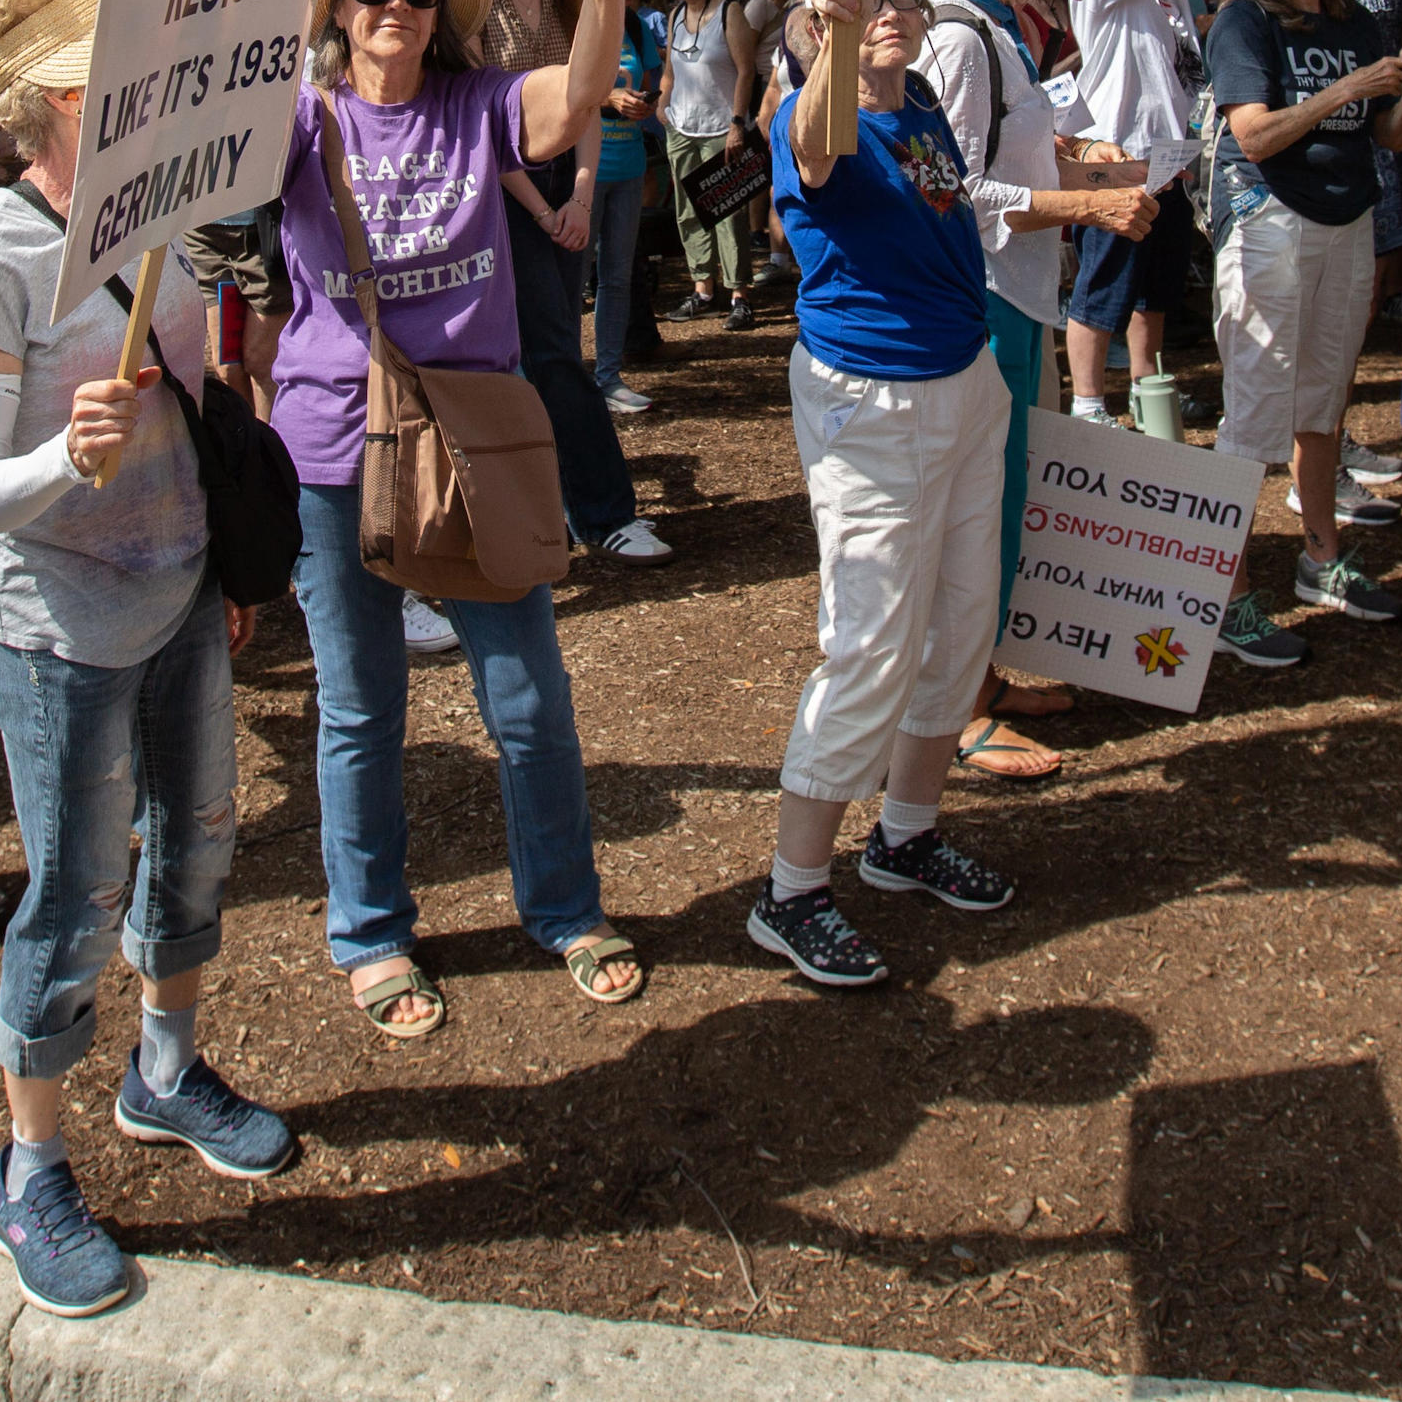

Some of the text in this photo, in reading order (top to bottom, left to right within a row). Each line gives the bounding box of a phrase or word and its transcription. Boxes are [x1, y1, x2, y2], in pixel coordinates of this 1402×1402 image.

[1286, 47, 1358, 76] LOVE
[97, 34, 301, 153] LIKE IT'S 1933
[1295, 76, 1315, 87] THY
[1320, 119, 1365, 131] PRESIDENT
[348, 150, 448, 182] RAGE
[699, 164, 732, 190] FIGHT
[89, 128, 253, 265] GERMANY
[330, 173, 478, 222] GAINST
[711, 173, 767, 216] TAKEOVER
[368, 225, 449, 261] THE
[1042, 460, 1242, 529] UNLESS YOU
[1054, 512, 1239, 577] REPUBLICANS
[1094, 577, 1164, 610] WHAT
[1045, 621, 1111, 659] HEY
